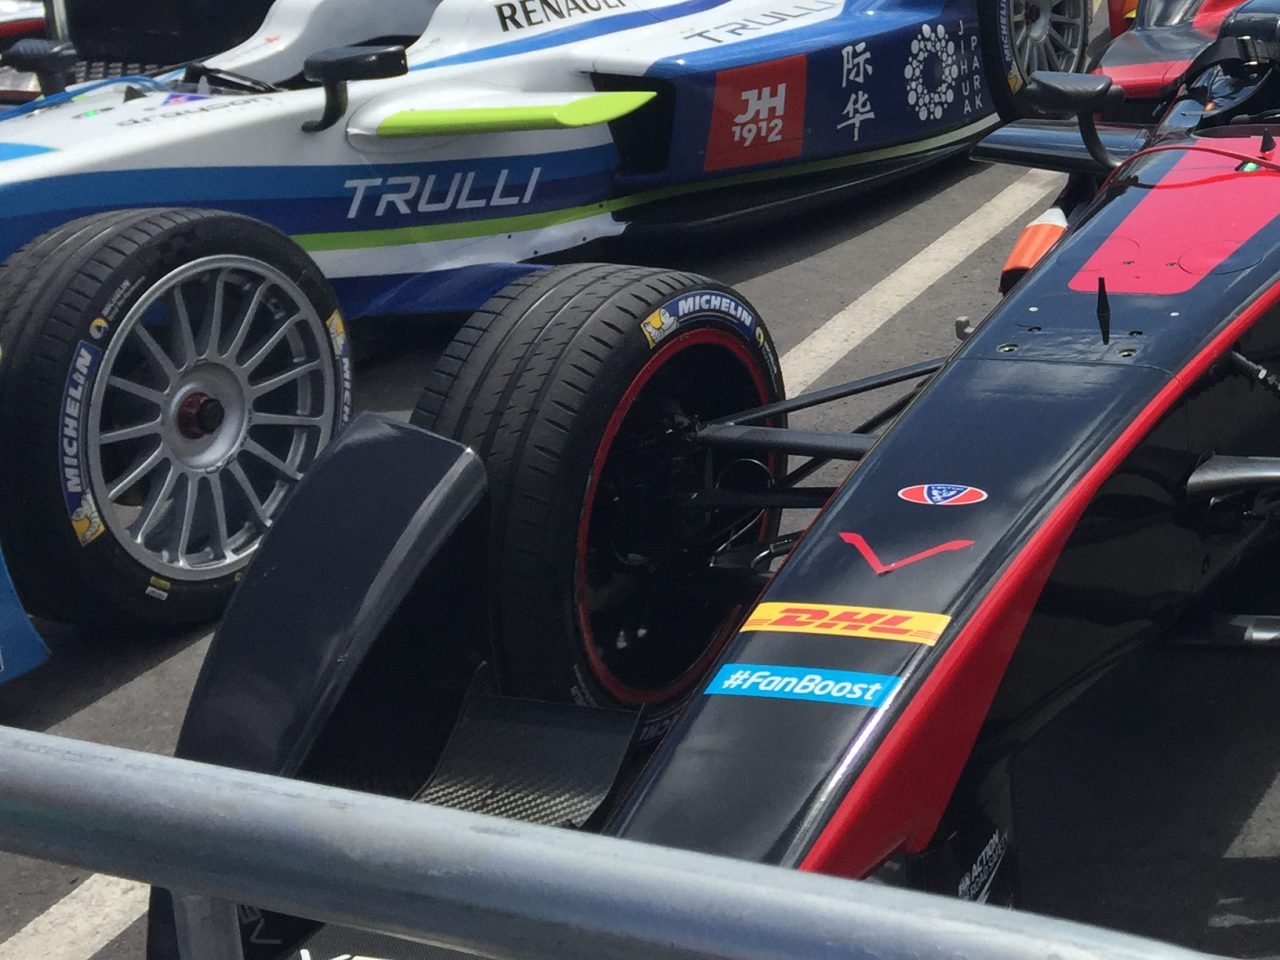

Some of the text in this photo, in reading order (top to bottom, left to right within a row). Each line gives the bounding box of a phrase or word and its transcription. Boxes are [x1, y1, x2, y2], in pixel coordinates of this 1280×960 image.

[683, 0, 838, 44] TRULLI
[836, 40, 876, 141] 际华
[731, 118, 784, 148] 1912
[342, 165, 542, 219] TRULLI
[678, 294, 753, 327] MICHELIN
[61, 347, 93, 493] MICHELIN
[776, 607, 919, 636] DHL
[721, 668, 883, 702] #FanBoost
